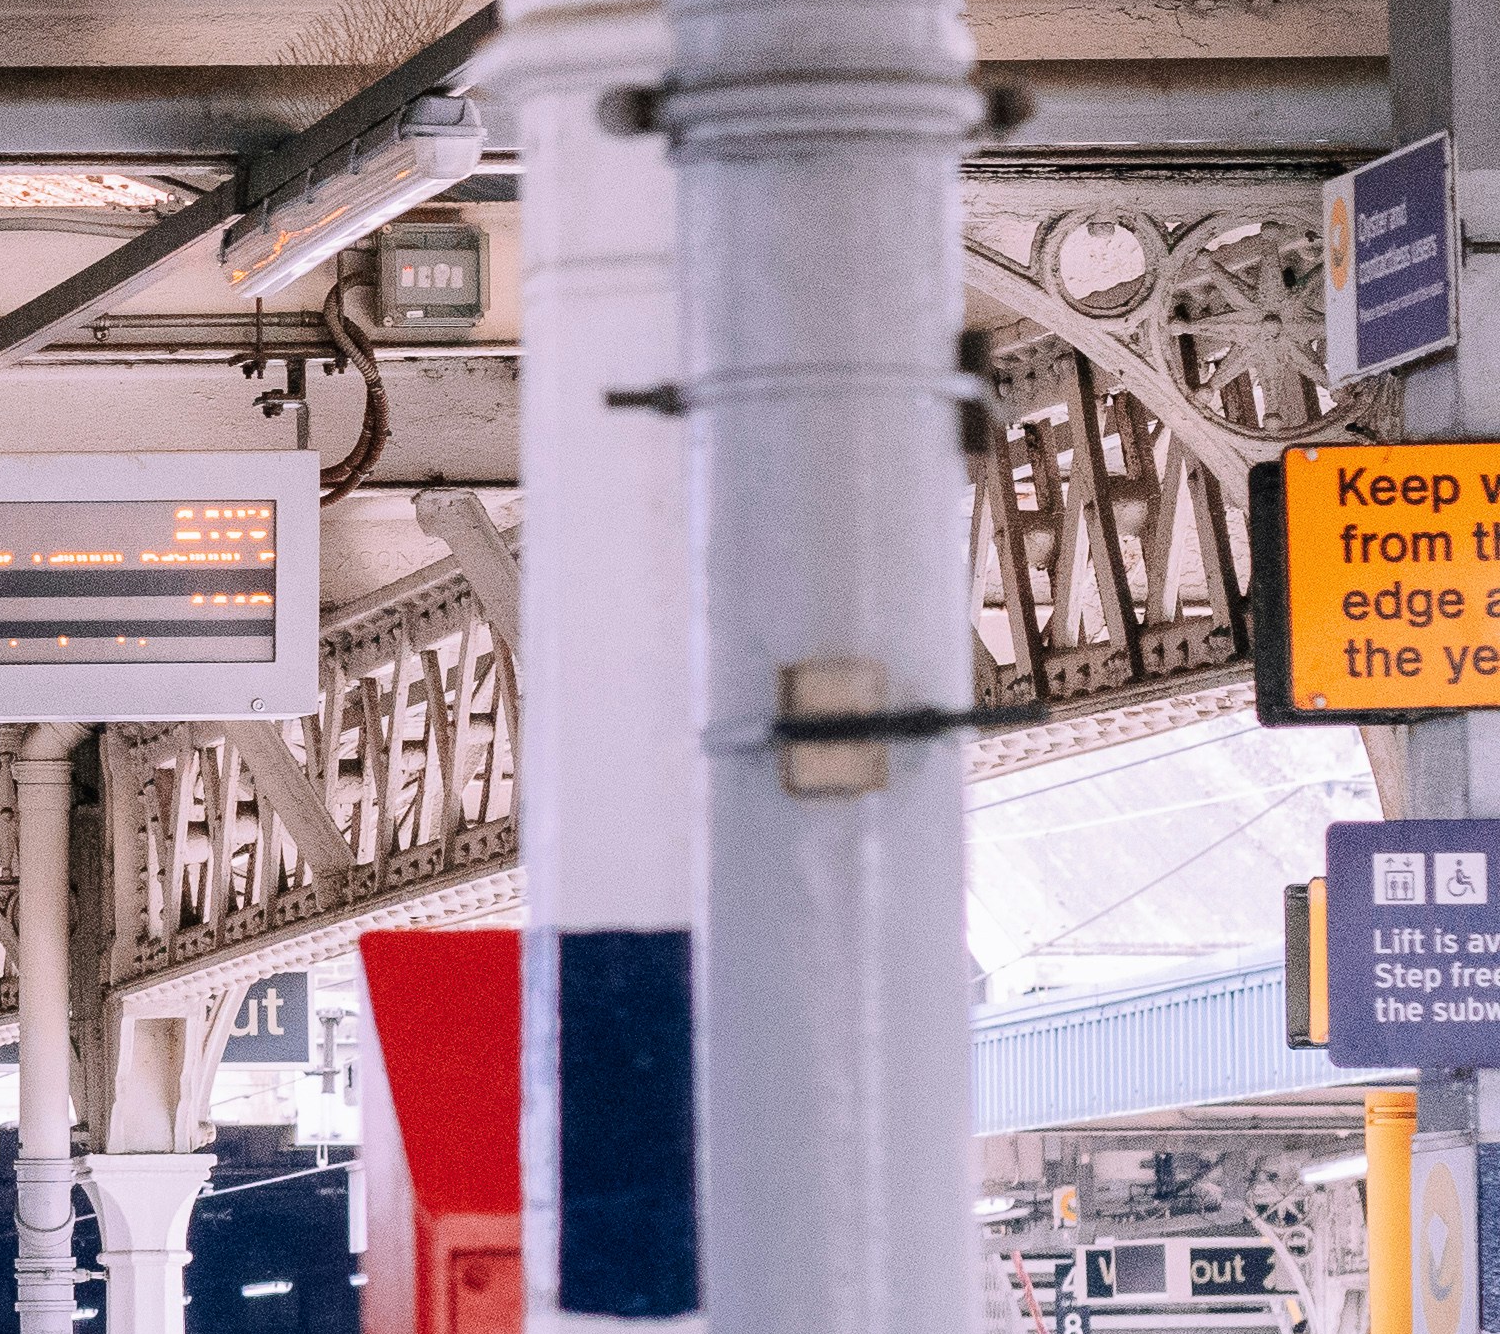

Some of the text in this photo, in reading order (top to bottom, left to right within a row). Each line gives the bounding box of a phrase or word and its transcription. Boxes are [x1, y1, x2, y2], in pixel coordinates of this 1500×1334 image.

[1337, 467, 1461, 512] Keep
[1340, 523, 1452, 563] from
[1342, 581, 1466, 627] edge
[1345, 638, 1422, 678] the
[1374, 929, 1425, 955] Lift
[1435, 928, 1458, 954] is
[1375, 964, 1442, 992] Step
[1376, 997, 1423, 1022] the
[1190, 1253, 1246, 1286] out
